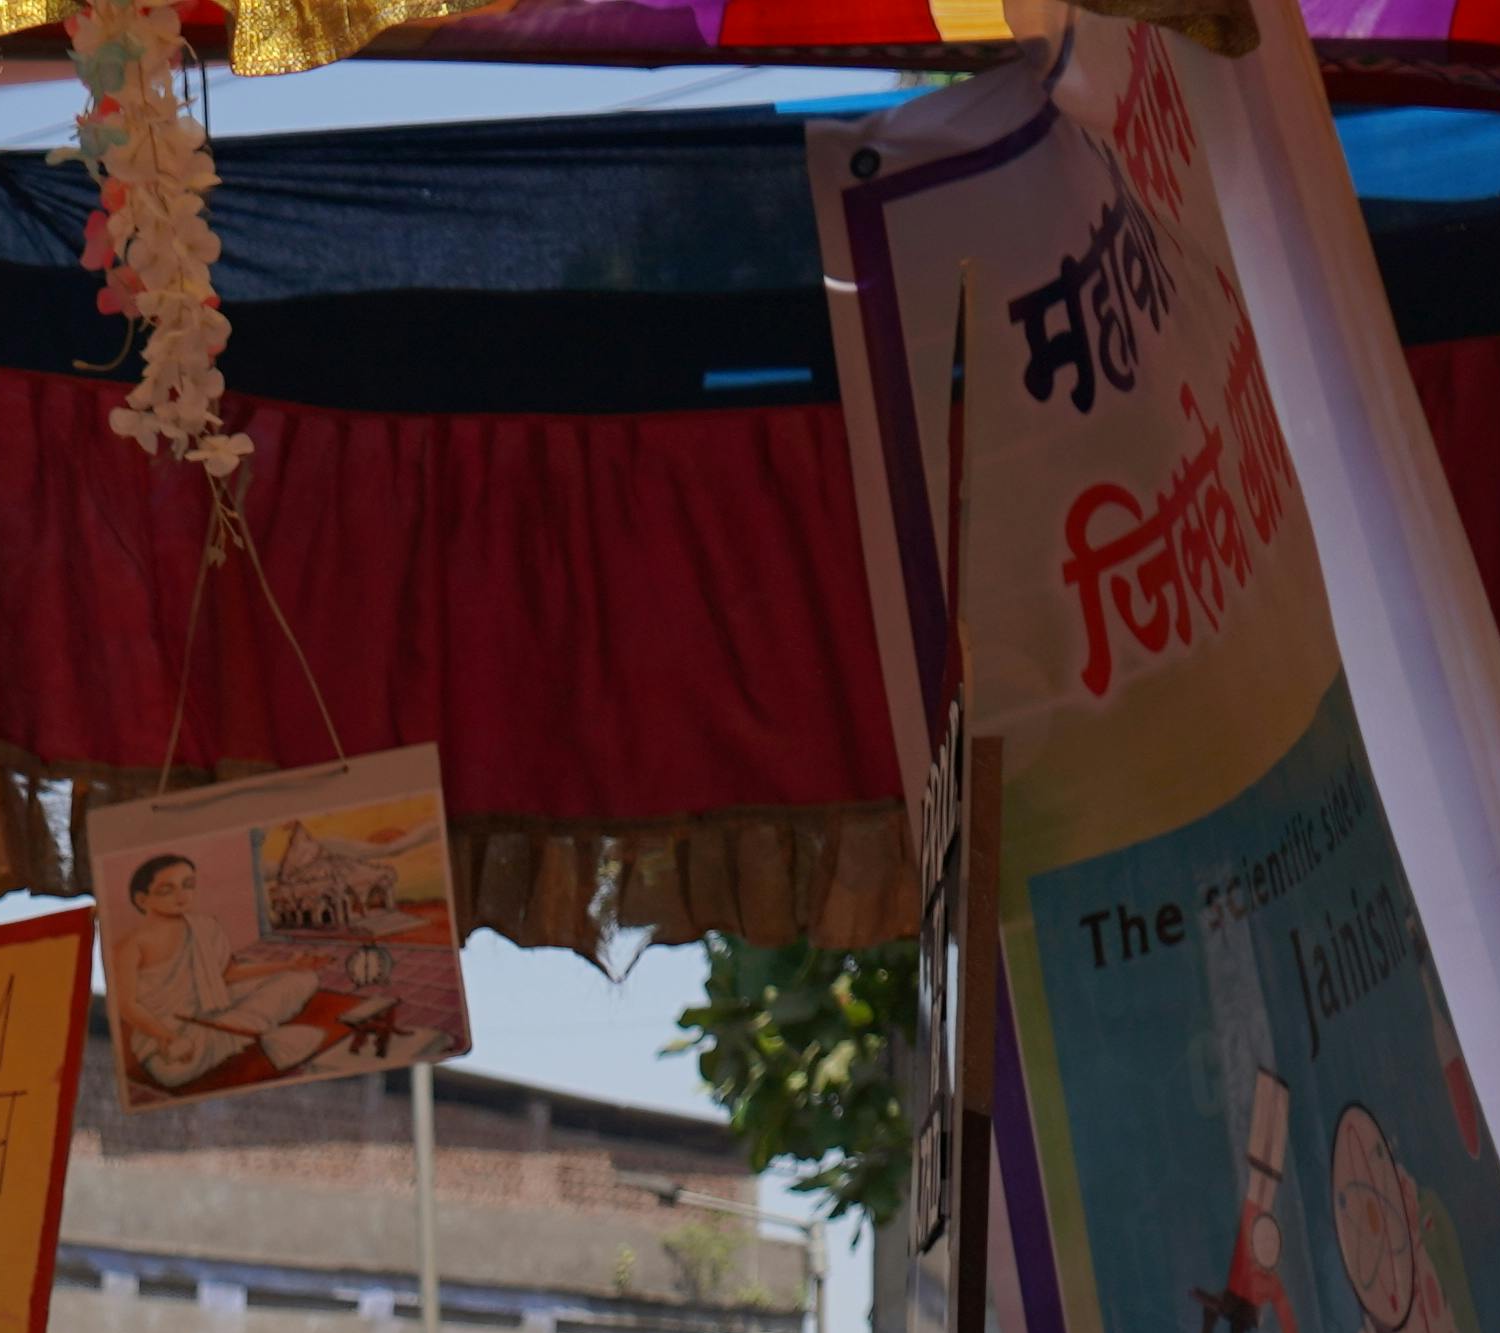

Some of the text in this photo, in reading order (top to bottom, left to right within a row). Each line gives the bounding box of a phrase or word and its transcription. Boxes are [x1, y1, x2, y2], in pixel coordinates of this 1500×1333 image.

[1079, 901, 1185, 969] The
[1205, 811, 1321, 930] scientific
[1290, 880, 1408, 1061] Jainism
